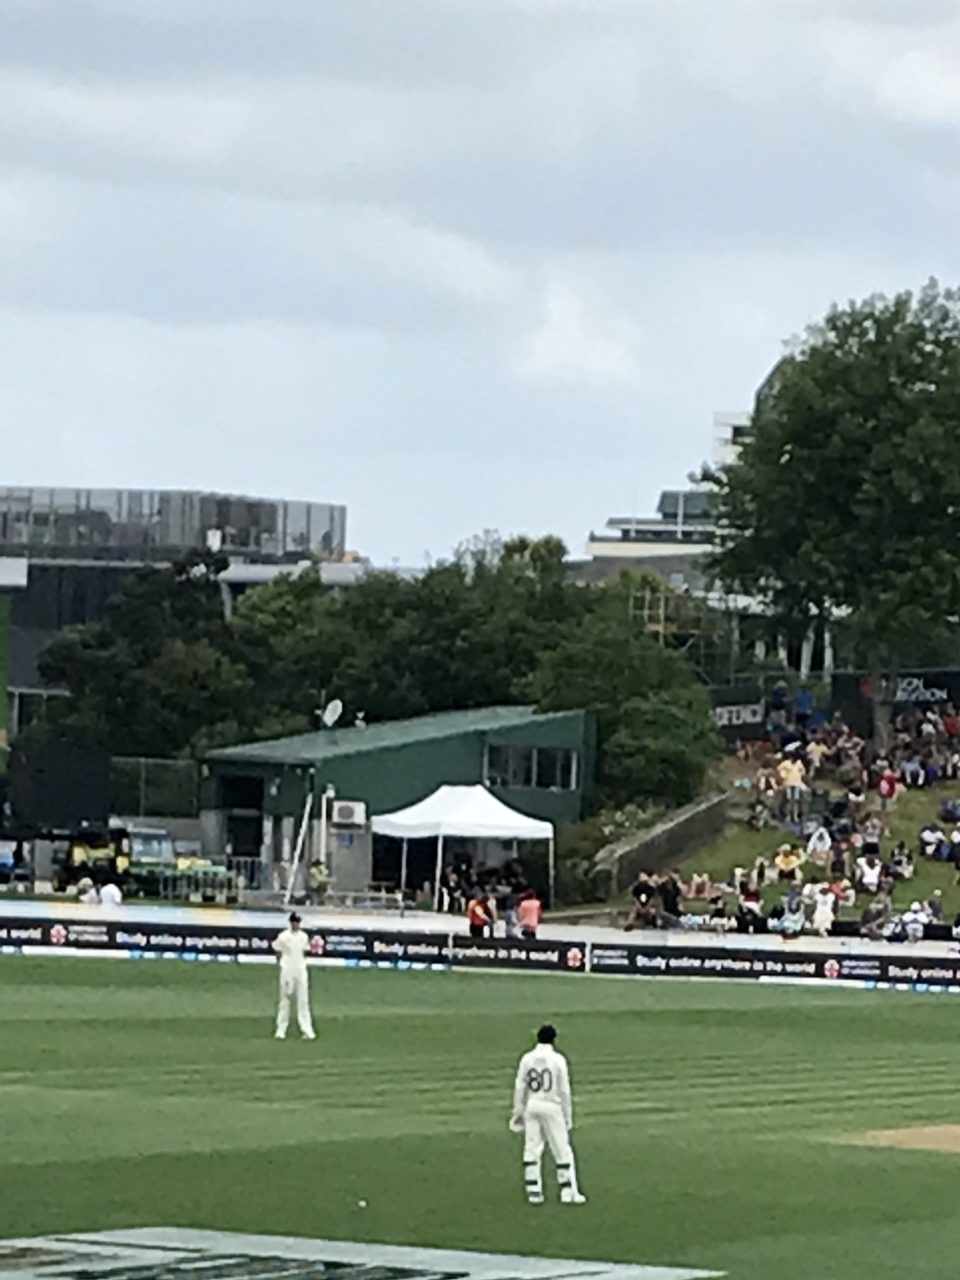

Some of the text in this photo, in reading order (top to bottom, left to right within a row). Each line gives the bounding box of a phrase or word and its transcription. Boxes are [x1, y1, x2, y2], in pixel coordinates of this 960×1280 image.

[669, 957, 701, 968] online
[703, 958, 751, 971] anywhere
[527, 1067, 553, 1093] 80
